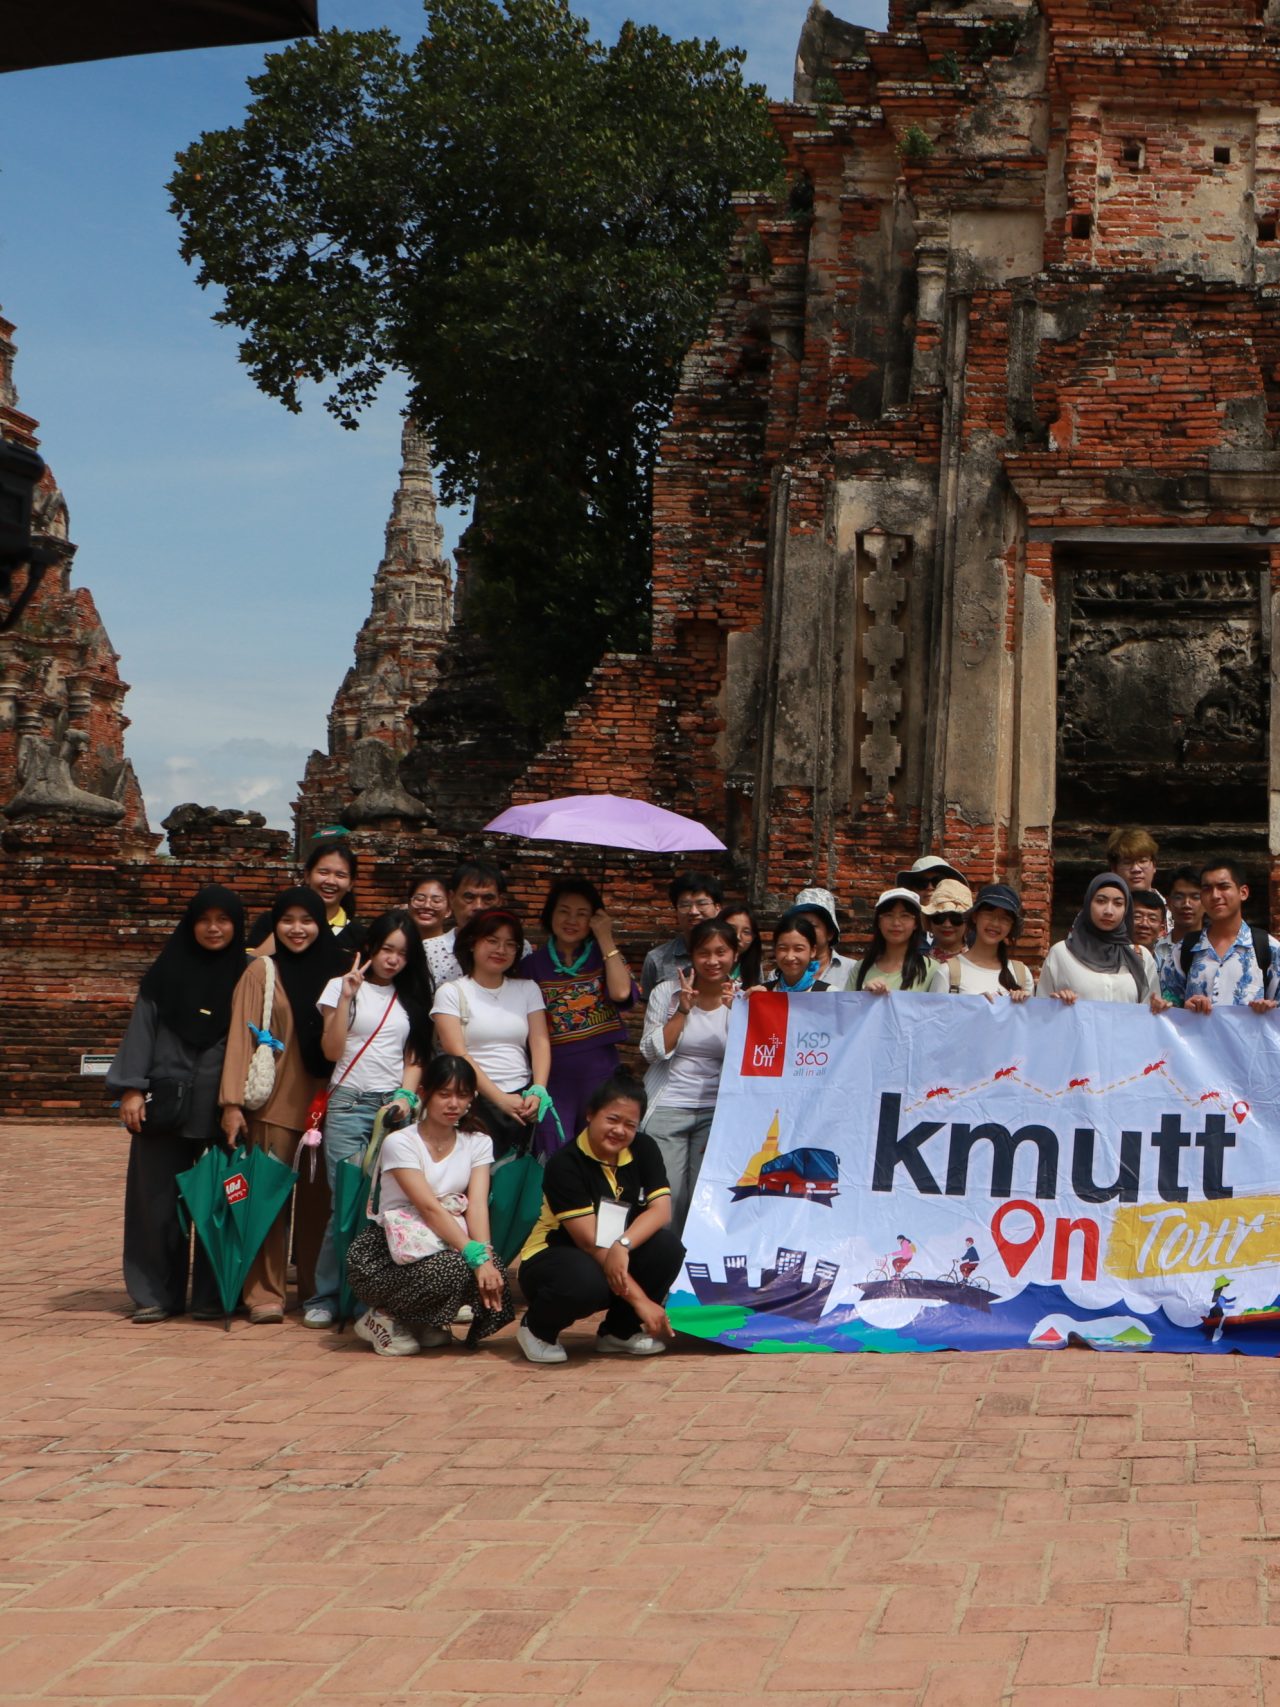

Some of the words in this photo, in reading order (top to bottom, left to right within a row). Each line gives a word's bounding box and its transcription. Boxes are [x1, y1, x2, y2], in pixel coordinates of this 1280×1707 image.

[796, 1031, 831, 1049] KSD
[754, 1045, 776, 1056] KM
[795, 1049, 829, 1066] 360
[805, 1068, 814, 1077] in
[872, 1092, 1236, 1203] kmutt
[1136, 1208, 1266, 1273] Tour
